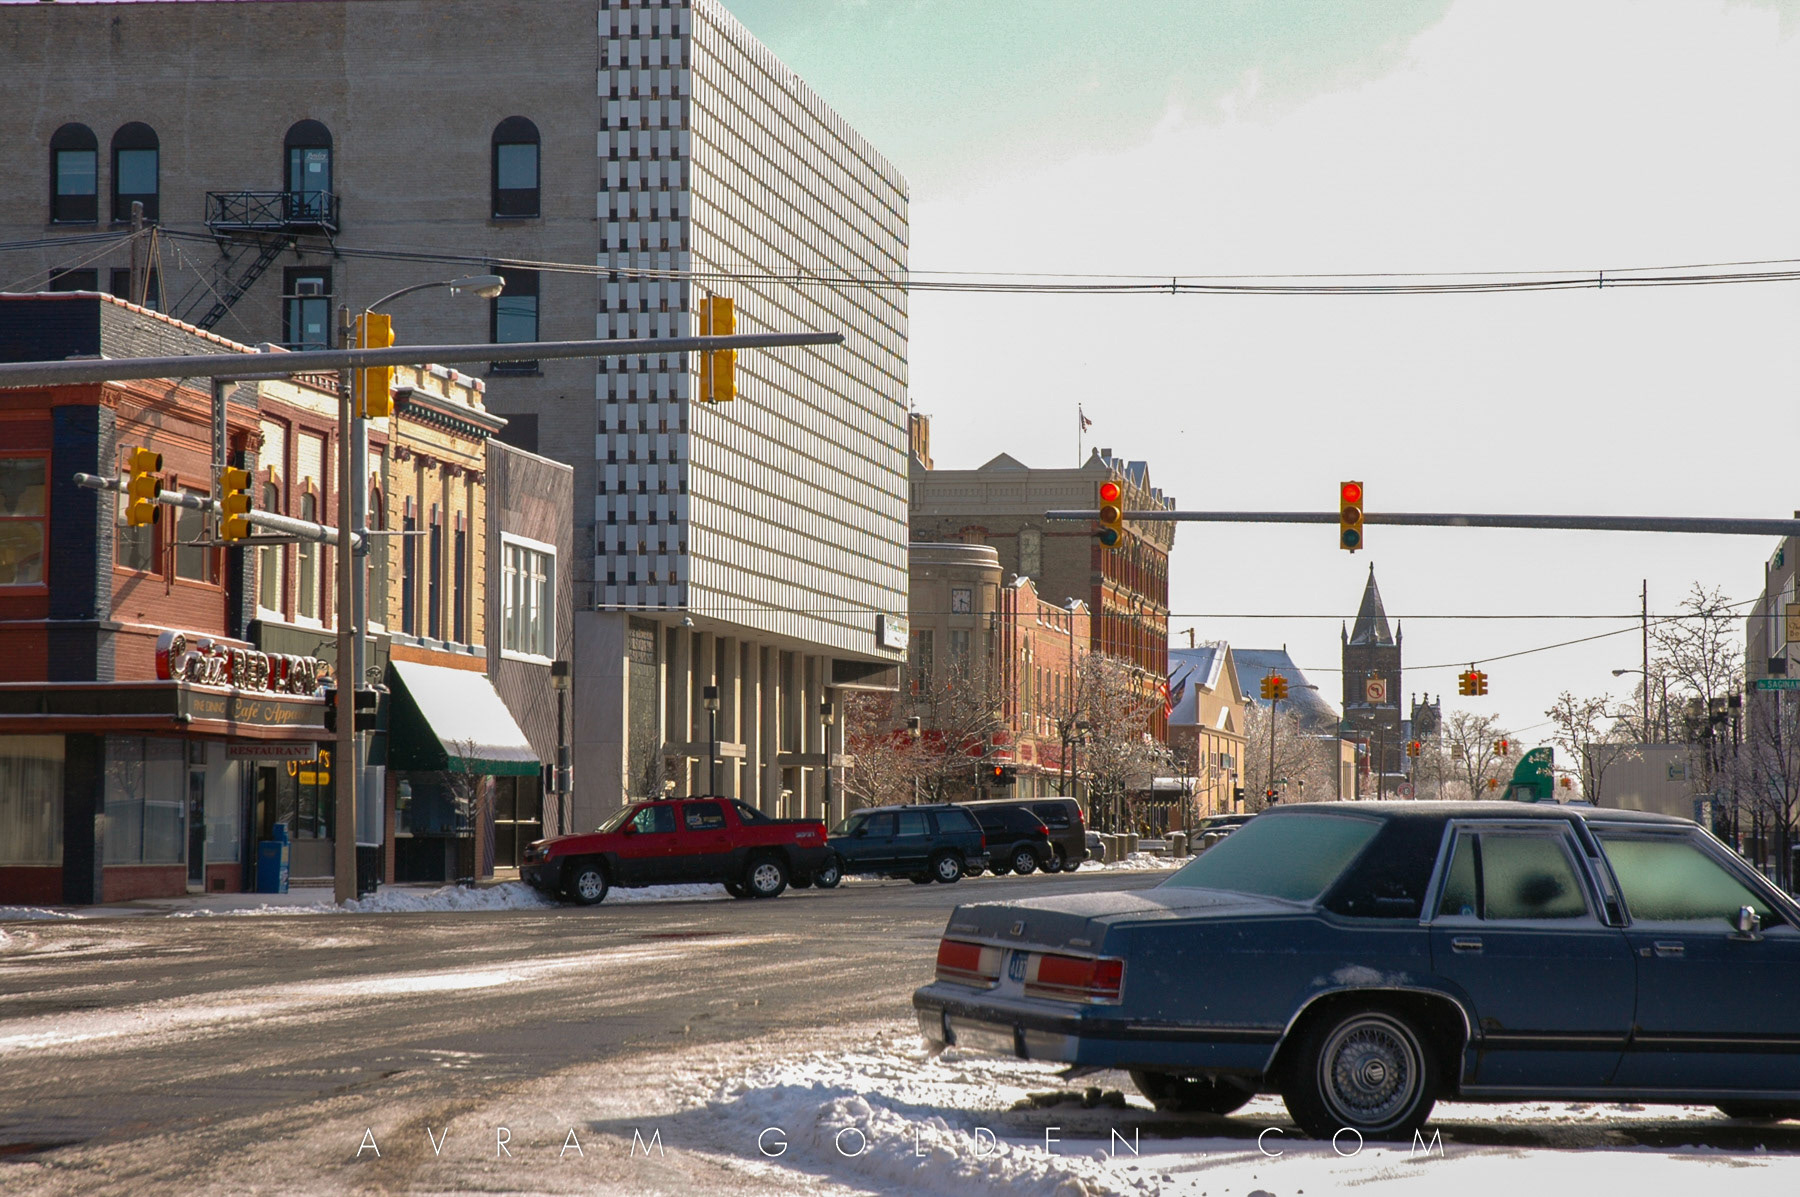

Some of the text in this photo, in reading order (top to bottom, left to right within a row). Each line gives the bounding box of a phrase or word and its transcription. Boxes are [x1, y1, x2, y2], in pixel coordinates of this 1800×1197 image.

[231, 648, 270, 692] RED
[267, 652, 317, 697] LION
[229, 745, 310, 756] RESTAURANT
